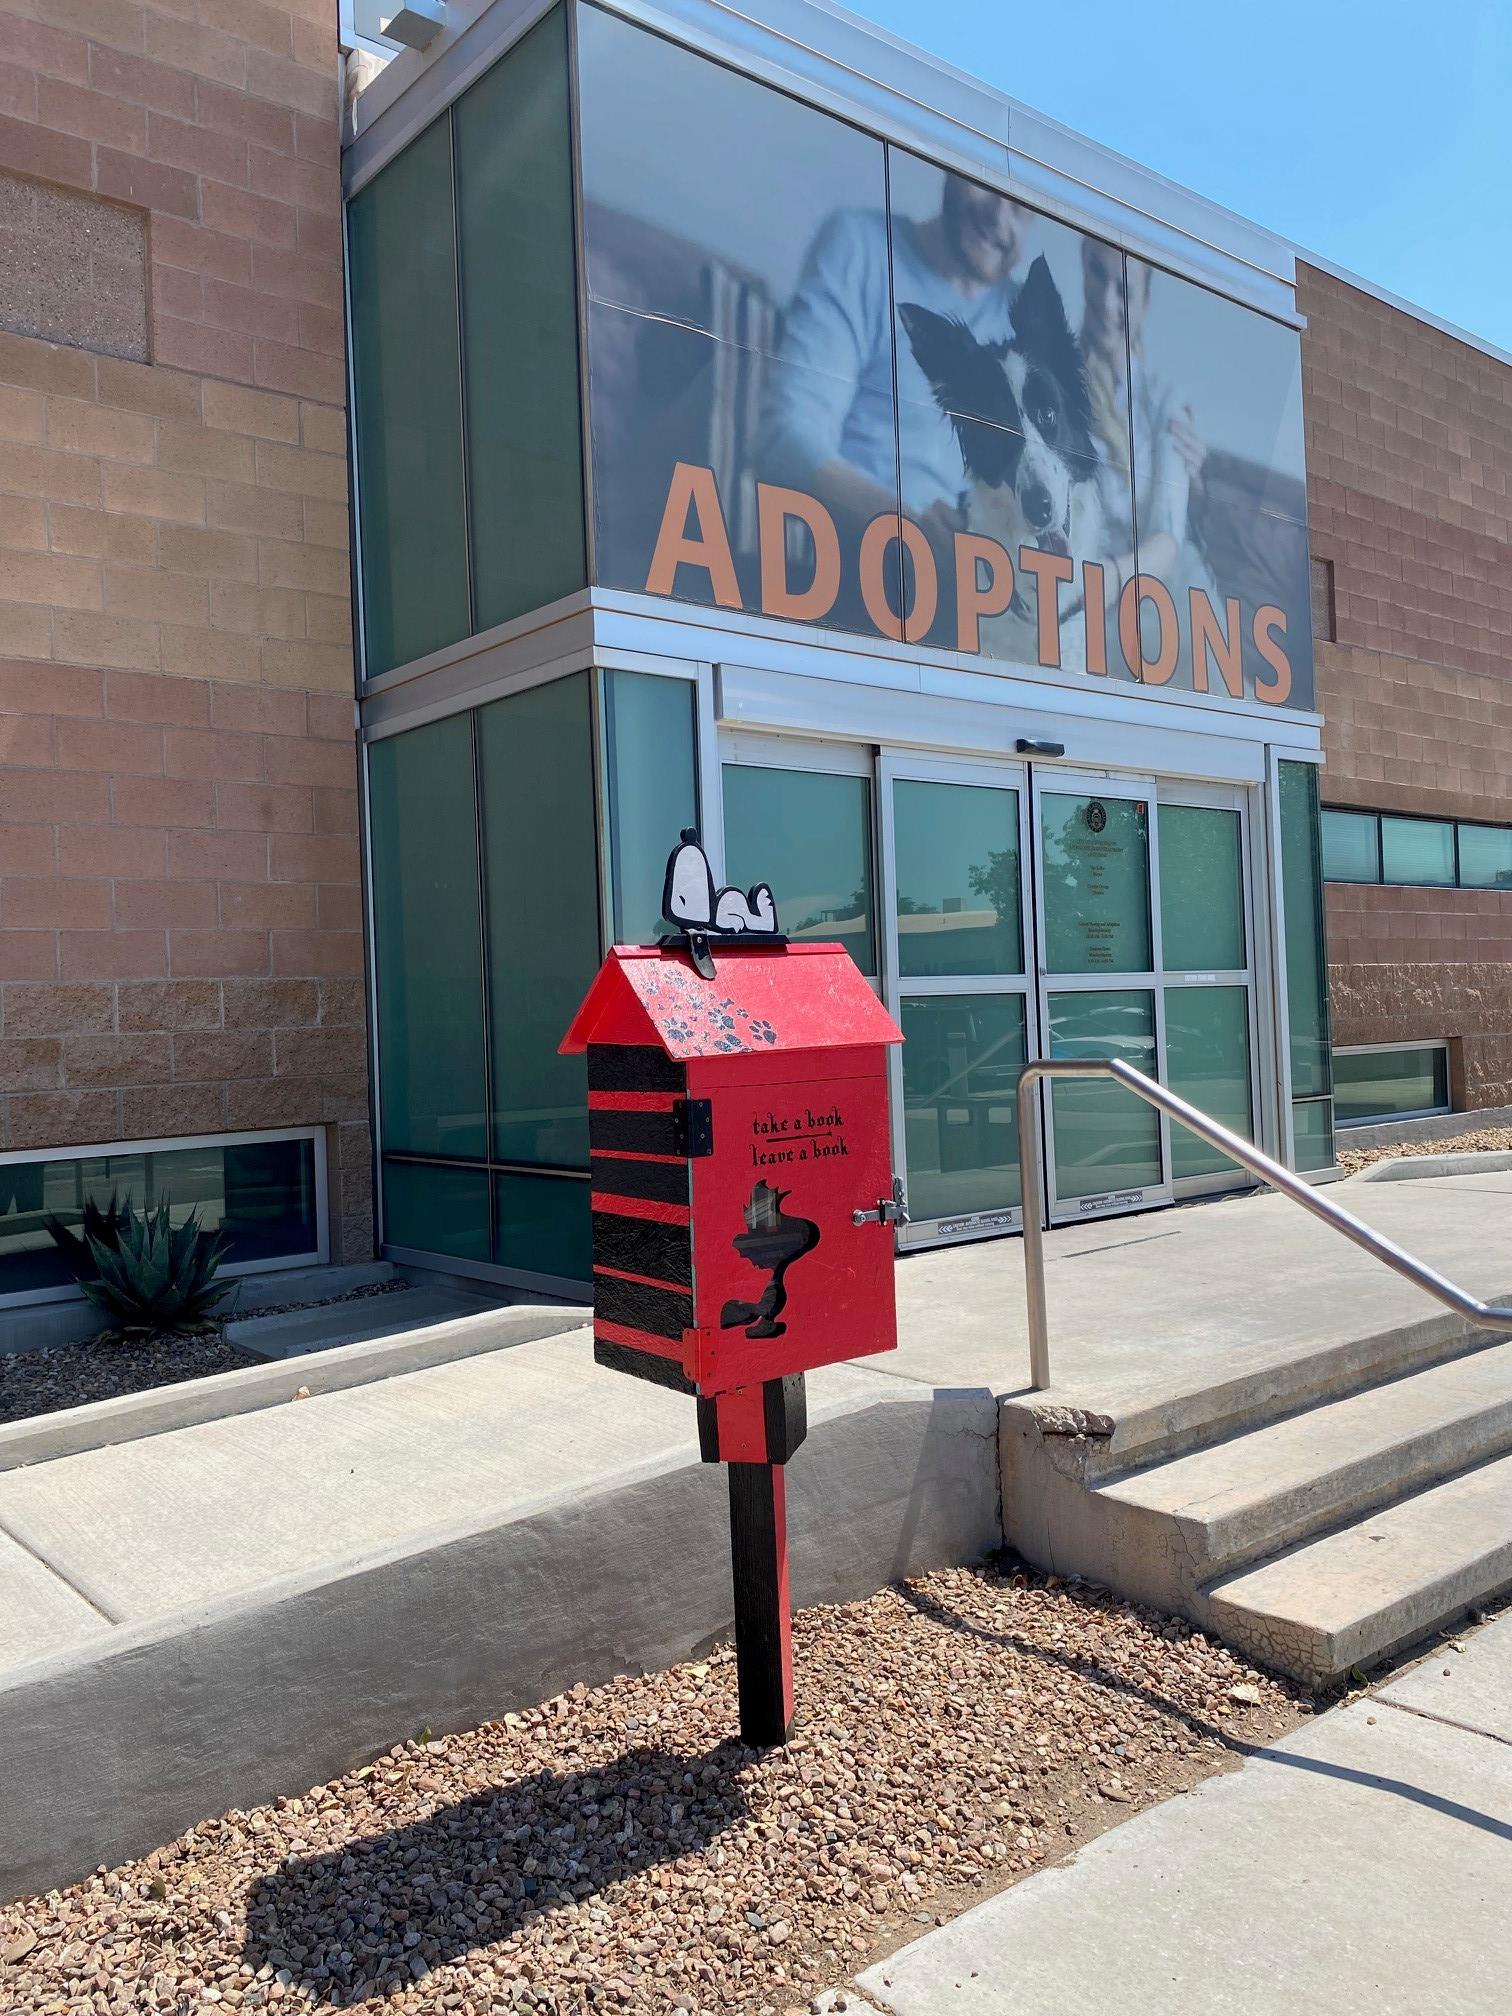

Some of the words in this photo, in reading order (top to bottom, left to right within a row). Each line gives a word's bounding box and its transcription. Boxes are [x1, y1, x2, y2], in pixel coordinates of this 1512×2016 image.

[644, 461, 1292, 704] ADOPTIONS
[752, 1110, 789, 1135] take
[793, 1119, 802, 1130] a
[805, 1106, 844, 1128] book
[749, 1143, 794, 1166] leave
[799, 1149, 807, 1160] a
[810, 1135, 848, 1159] book
